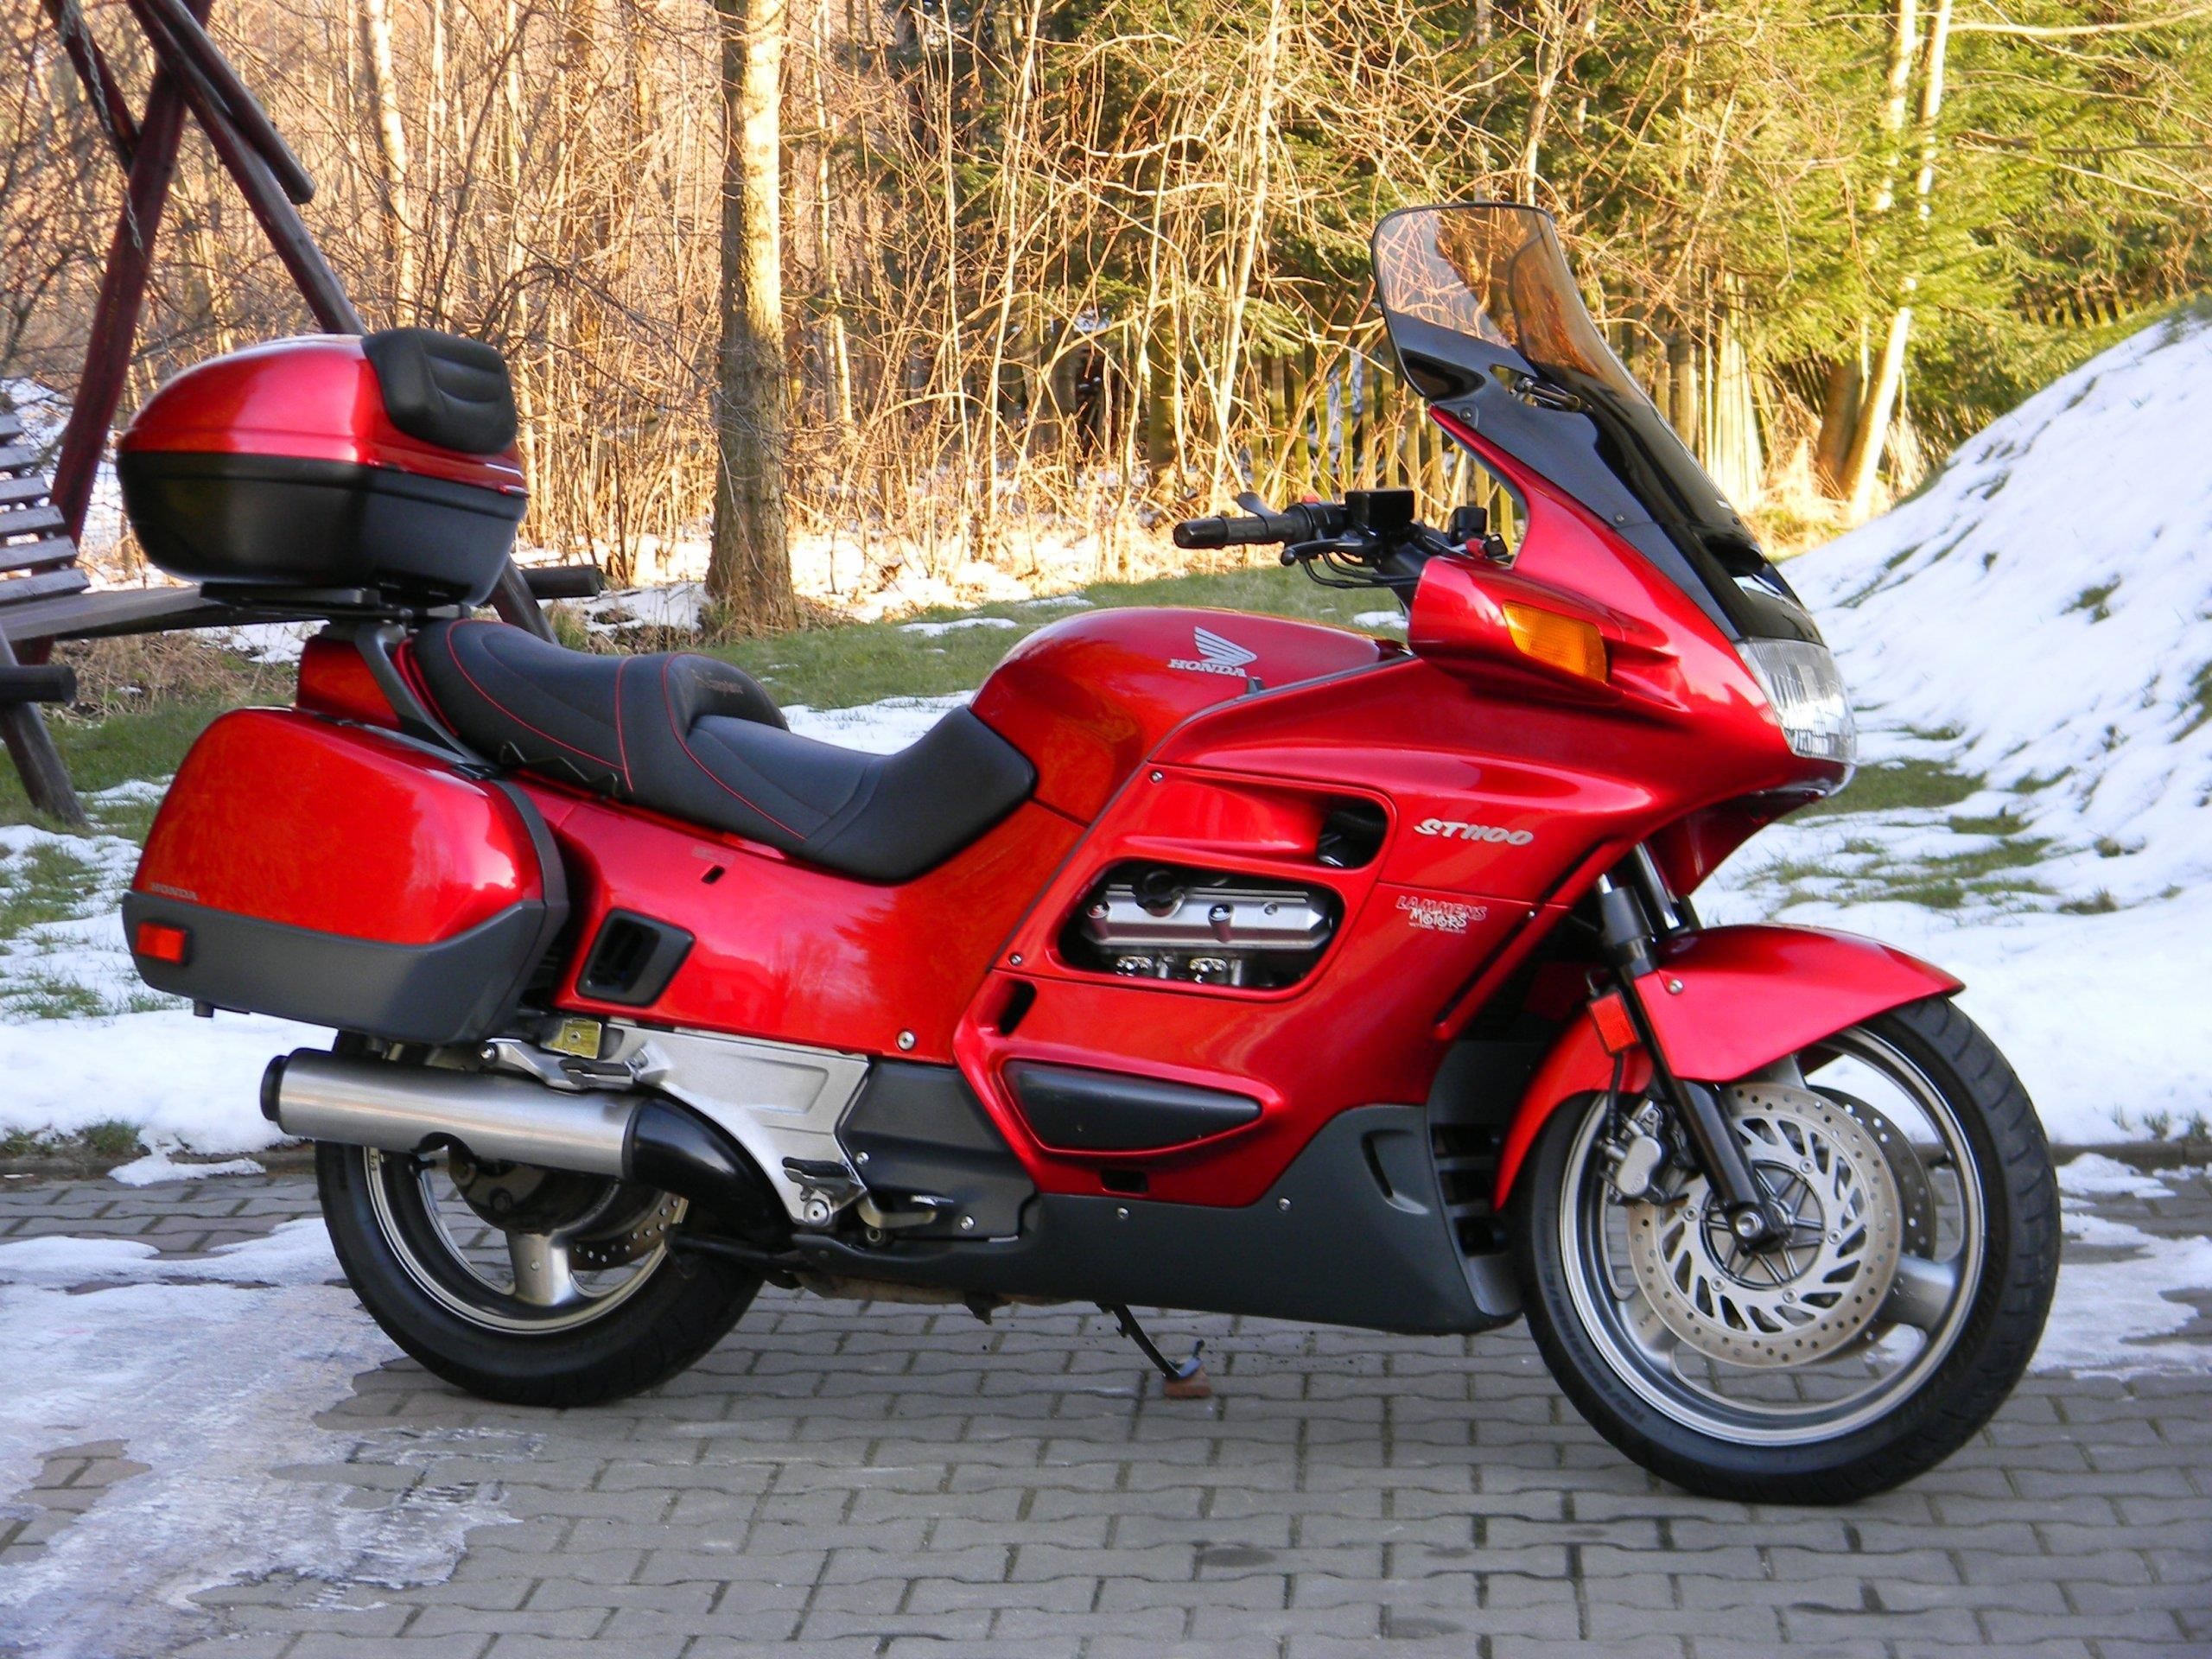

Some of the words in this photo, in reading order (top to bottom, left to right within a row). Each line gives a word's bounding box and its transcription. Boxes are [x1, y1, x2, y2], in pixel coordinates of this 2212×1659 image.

[1167, 658, 1247, 677] HONDA
[1414, 817, 1534, 845] ST1100
[151, 882, 197, 900] HONDA
